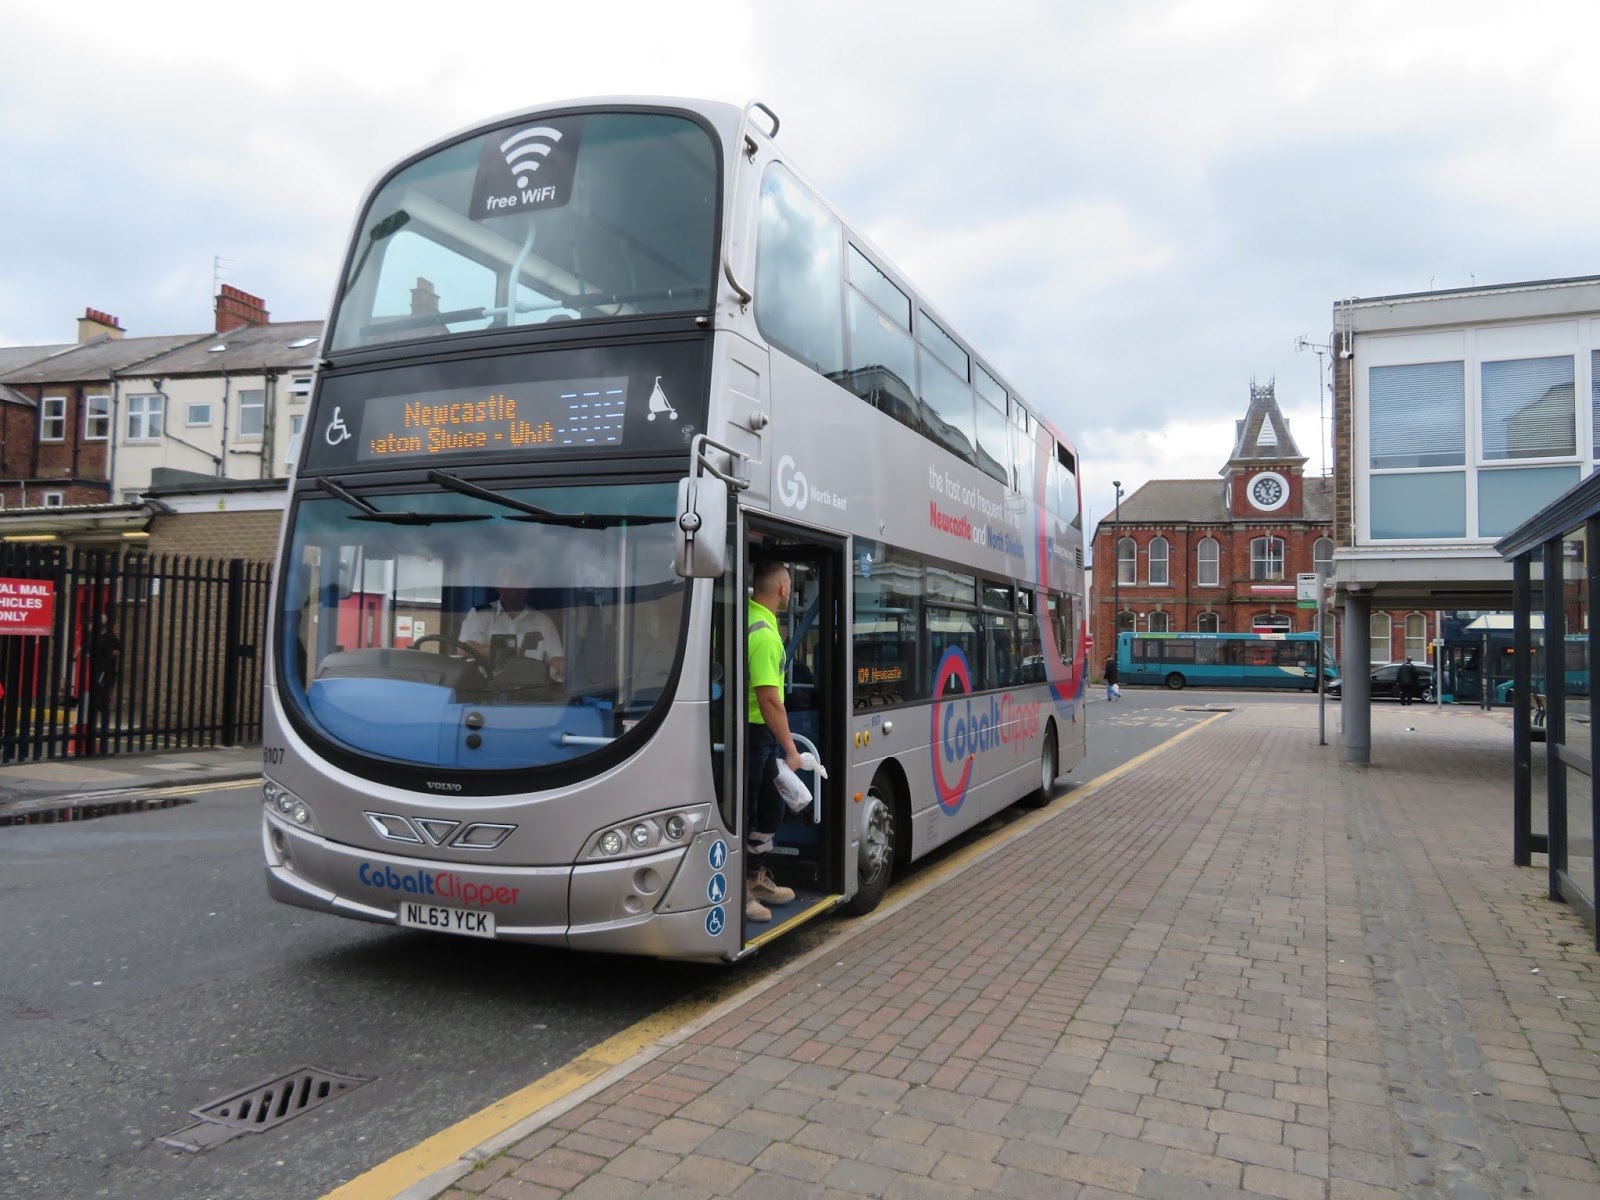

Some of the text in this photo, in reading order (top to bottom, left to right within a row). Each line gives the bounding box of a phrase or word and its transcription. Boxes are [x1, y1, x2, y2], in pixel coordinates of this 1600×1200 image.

[486, 185, 556, 210] free WiFi
[405, 394, 517, 427] Newcastle
[428, 427, 487, 452] Sluice
[510, 421, 553, 447] Whit
[810, 486, 832, 506] North
[832, 493, 847, 511] East
[928, 464, 944, 493] the
[945, 471, 961, 502] fast
[962, 486, 976, 509] and
[977, 488, 1004, 523] frequent
[929, 500, 972, 542] Newcastle
[972, 523, 986, 546] and
[987, 525, 1005, 553] North
[0, 583, 50, 596] AL MAIL
[871, 666, 902, 683] Newcastle
[426, 781, 462, 791] VOLVO
[407, 904, 488, 933] NL63 YCK
